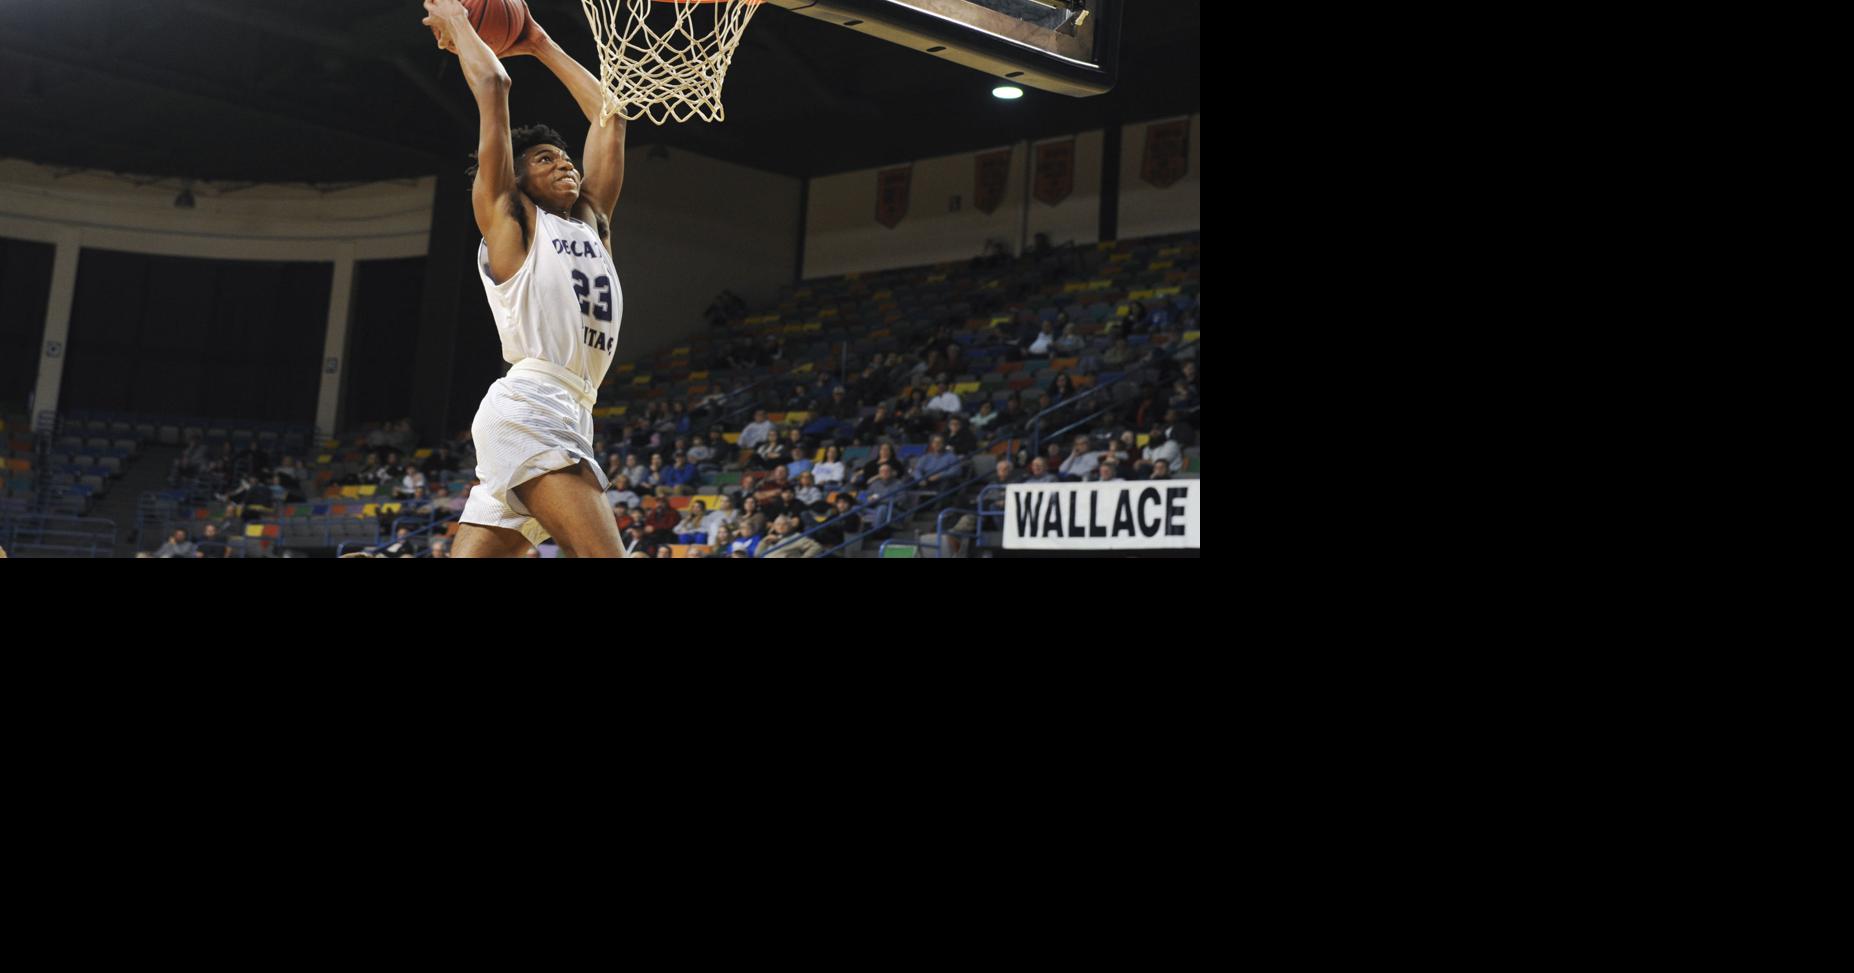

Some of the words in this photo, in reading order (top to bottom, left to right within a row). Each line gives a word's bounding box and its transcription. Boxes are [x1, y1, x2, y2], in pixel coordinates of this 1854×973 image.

[552, 238, 602, 259] DECA
[571, 269, 613, 322] 23
[1014, 487, 1189, 538] WALLACE
